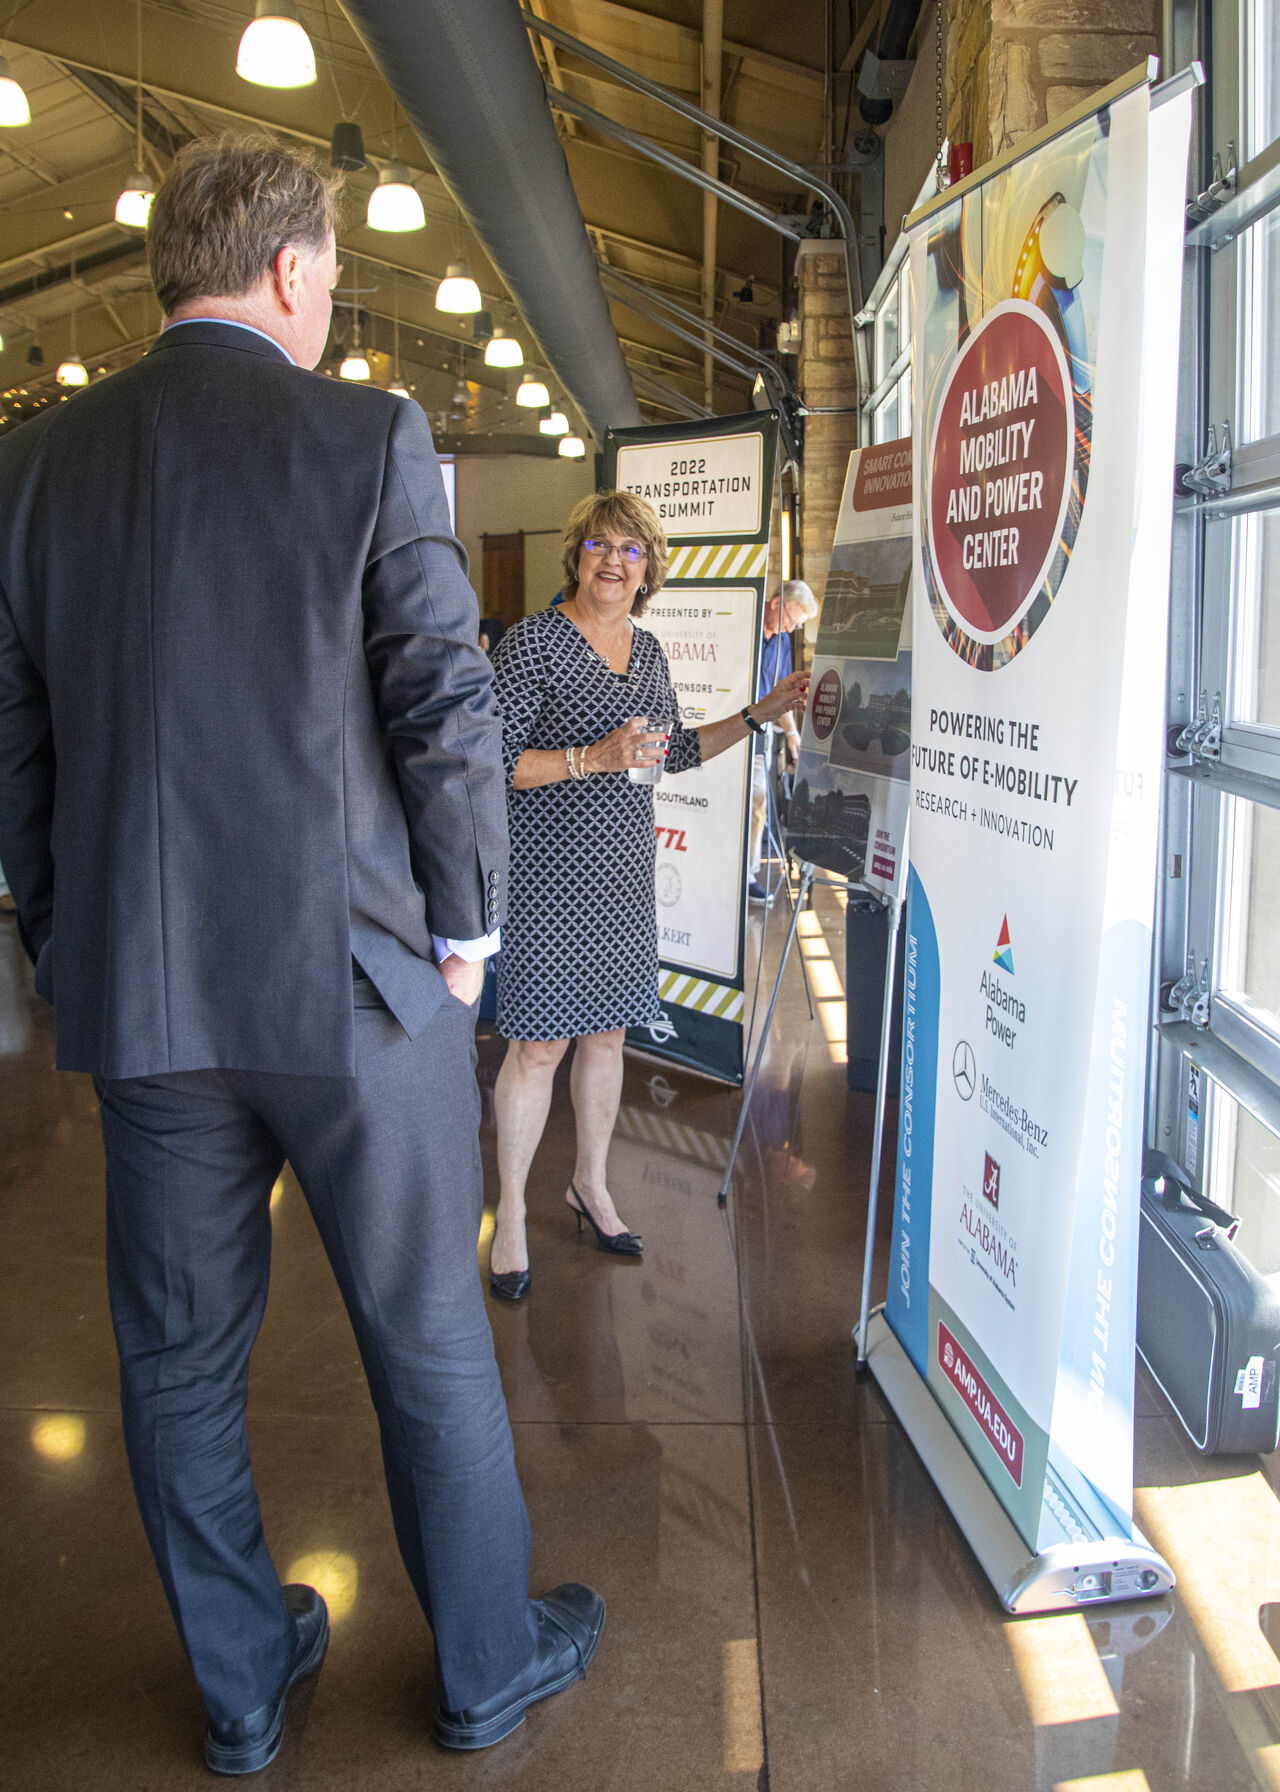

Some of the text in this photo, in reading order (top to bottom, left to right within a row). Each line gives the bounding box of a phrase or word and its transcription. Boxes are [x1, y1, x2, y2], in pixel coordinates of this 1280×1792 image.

[959, 366, 1038, 428] ALABAMA
[671, 459, 706, 476] 2022
[863, 454, 894, 476] SMART
[959, 418, 1035, 475] MOBILITY
[626, 476, 751, 498] TRANSPORTATION
[659, 501, 715, 518] SUMMIT
[946, 470, 1044, 524] AND POWER
[963, 526, 1019, 570] CENTER
[651, 608, 712, 618] PRESENTED BY
[664, 642, 717, 662] ABAMA
[673, 682, 713, 694] PONSORS
[930, 709, 1040, 751] POWERING THE
[912, 744, 1079, 807] FUTURE OF E-MOBILITY
[656, 791, 709, 808] SOUTHLAND
[915, 788, 967, 822] RESEARCH
[980, 807, 1054, 851] INNOVATION
[979, 969, 1026, 1024] Alabama
[985, 1004, 1017, 1050] Power
[900, 933, 919, 1309] JOIN THE CONSORTIUM
[980, 1072, 1049, 1148] Mercedes-Benz
[960, 1203, 1016, 1288] ALABAMA
[976, 1198, 1008, 1238] UNIVERSITY
[1008, 1237, 1018, 1251] OF
[1249, 1368, 1259, 1394] AMP
[954, 1357, 1016, 1462] AMP.UA.EDU
